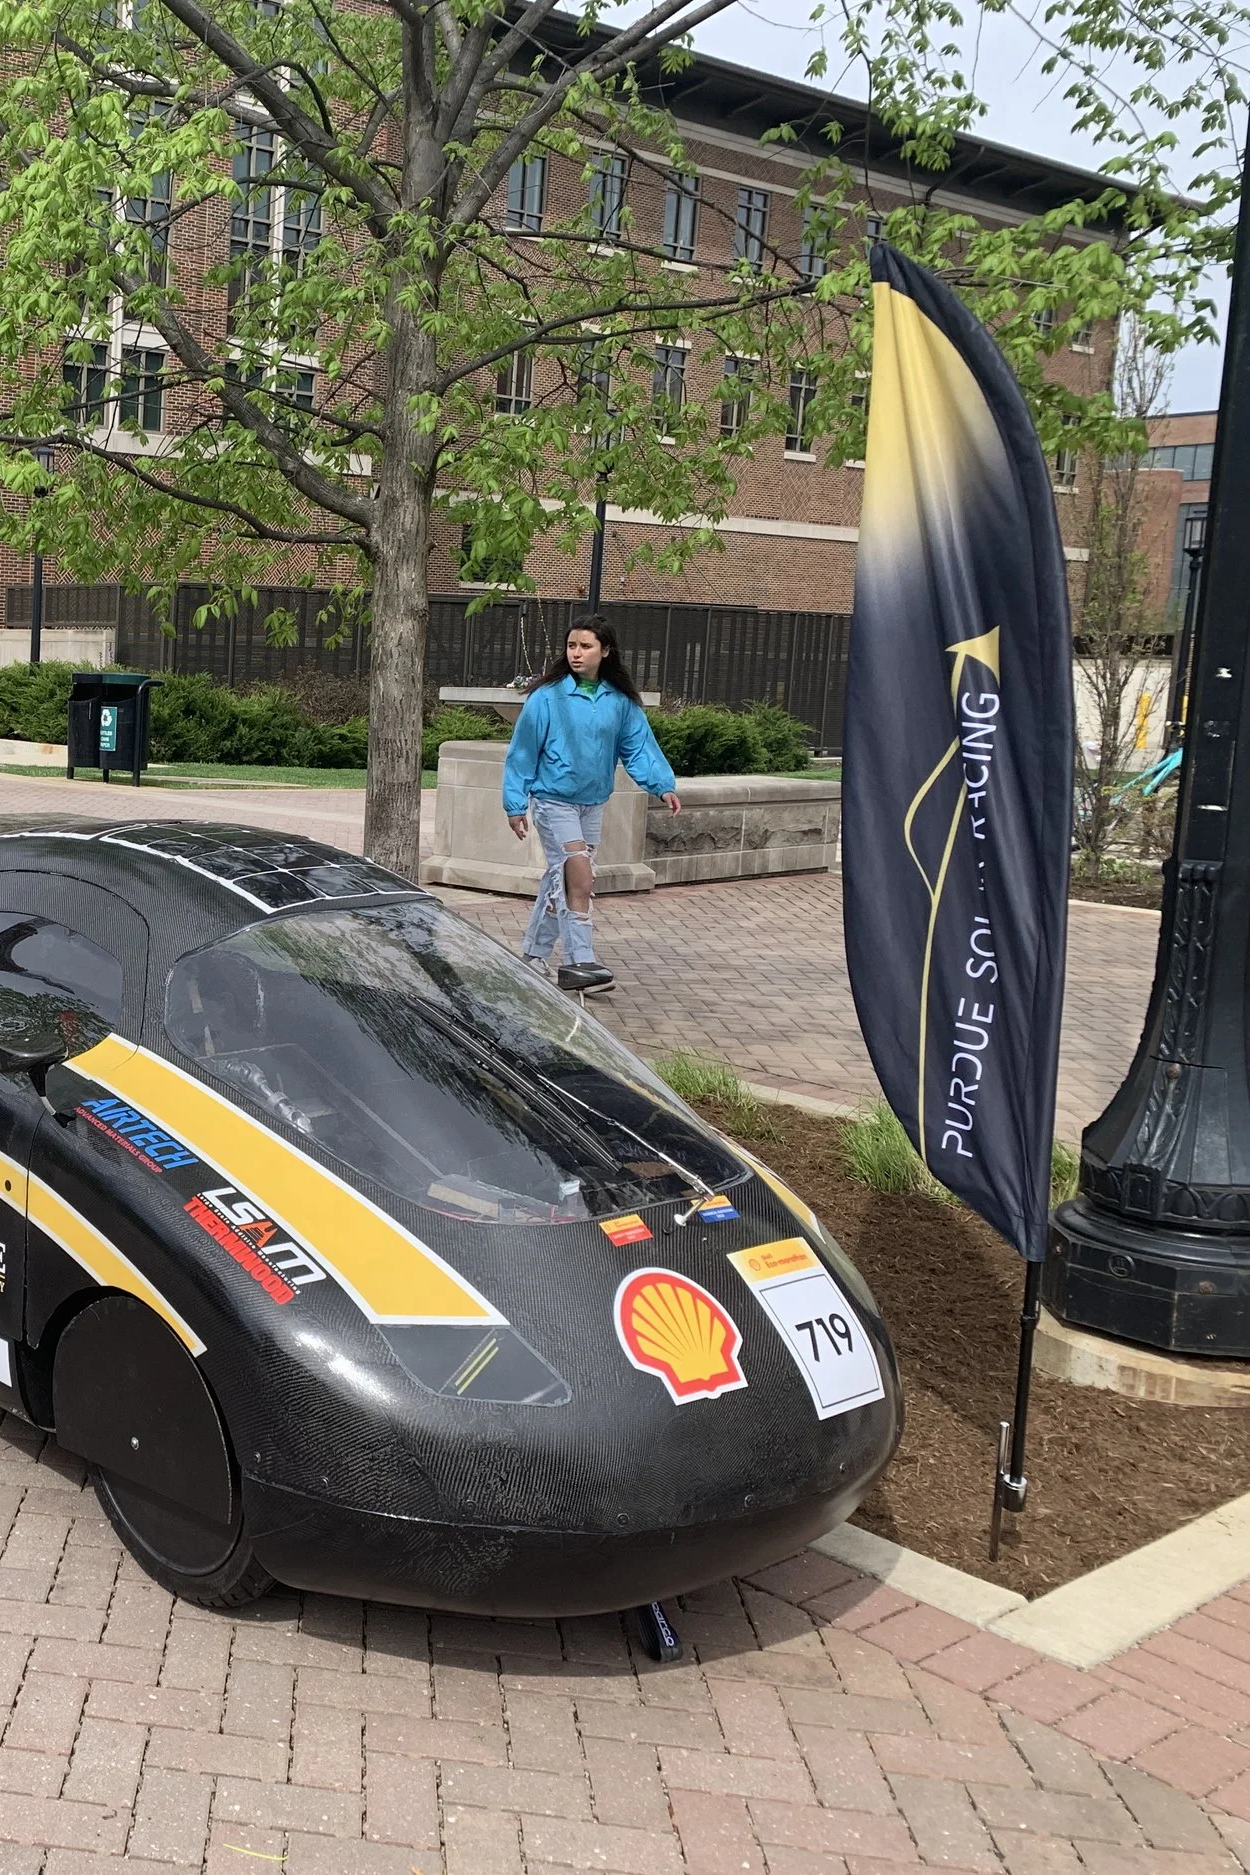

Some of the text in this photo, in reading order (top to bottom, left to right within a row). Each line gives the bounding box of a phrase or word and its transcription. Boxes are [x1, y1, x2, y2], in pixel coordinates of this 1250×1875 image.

[941, 997, 995, 1159] PURDUE
[74, 1106, 163, 1174] ADVANCED MATERIALS GROUP
[80, 1098, 199, 1170] AIRTECH
[182, 1195, 295, 1306] THERMWOOD
[202, 1186, 327, 1286] LSAM
[794, 1312, 855, 1363] 719
